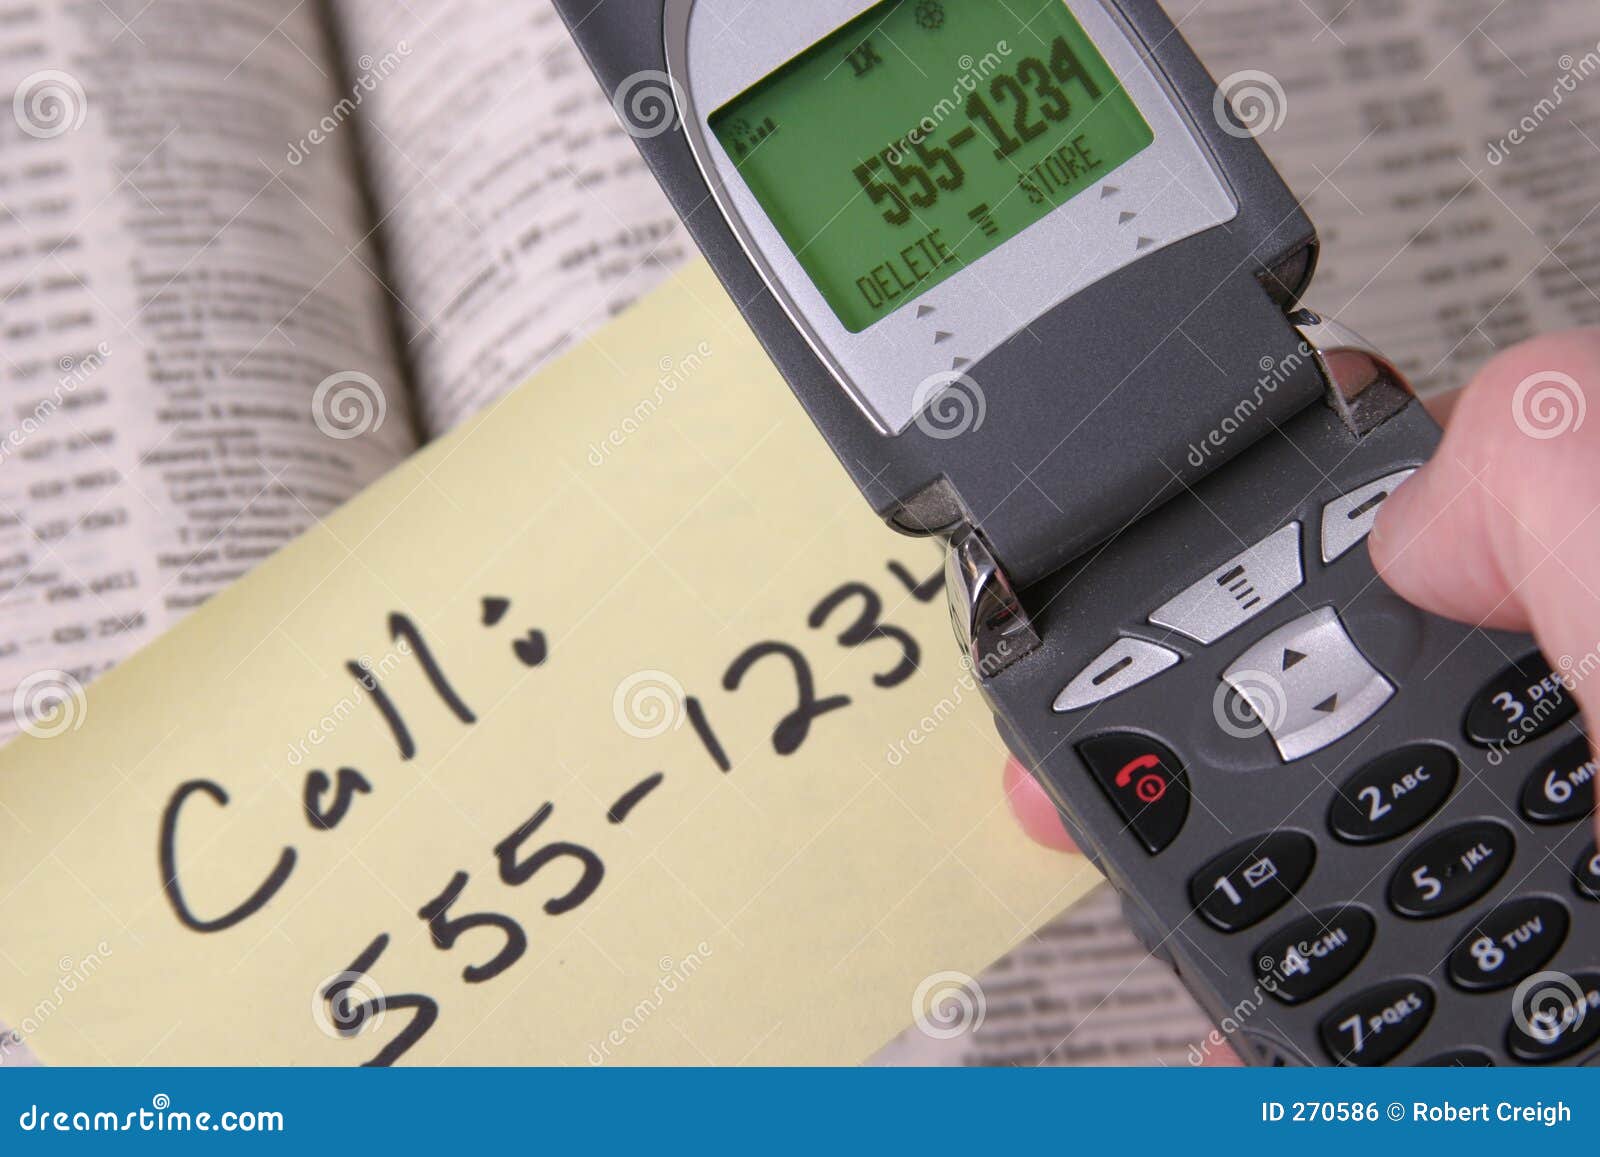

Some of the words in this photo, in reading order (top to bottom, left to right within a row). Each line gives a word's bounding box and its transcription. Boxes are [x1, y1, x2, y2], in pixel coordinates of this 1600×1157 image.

[852, 34, 1102, 227] 555-1234
[855, 228, 960, 310] DELETE
[1017, 134, 1104, 205] STORE
[1492, 690, 1526, 724] 3
[157, 595, 549, 934] Call:
[1358, 784, 1392, 822] 2
[1391, 764, 1432, 800] ABC
[1543, 768, 1573, 804] 6
[1214, 875, 1242, 906] 1
[1411, 864, 1443, 901] 5
[1460, 842, 1494, 873] JKL
[1284, 944, 1311, 977] 4
[1470, 936, 1506, 974] 8
[1501, 915, 1545, 951] TUV
[1337, 1013, 1365, 1054] 7
[1368, 992, 1423, 1034] PQRS
